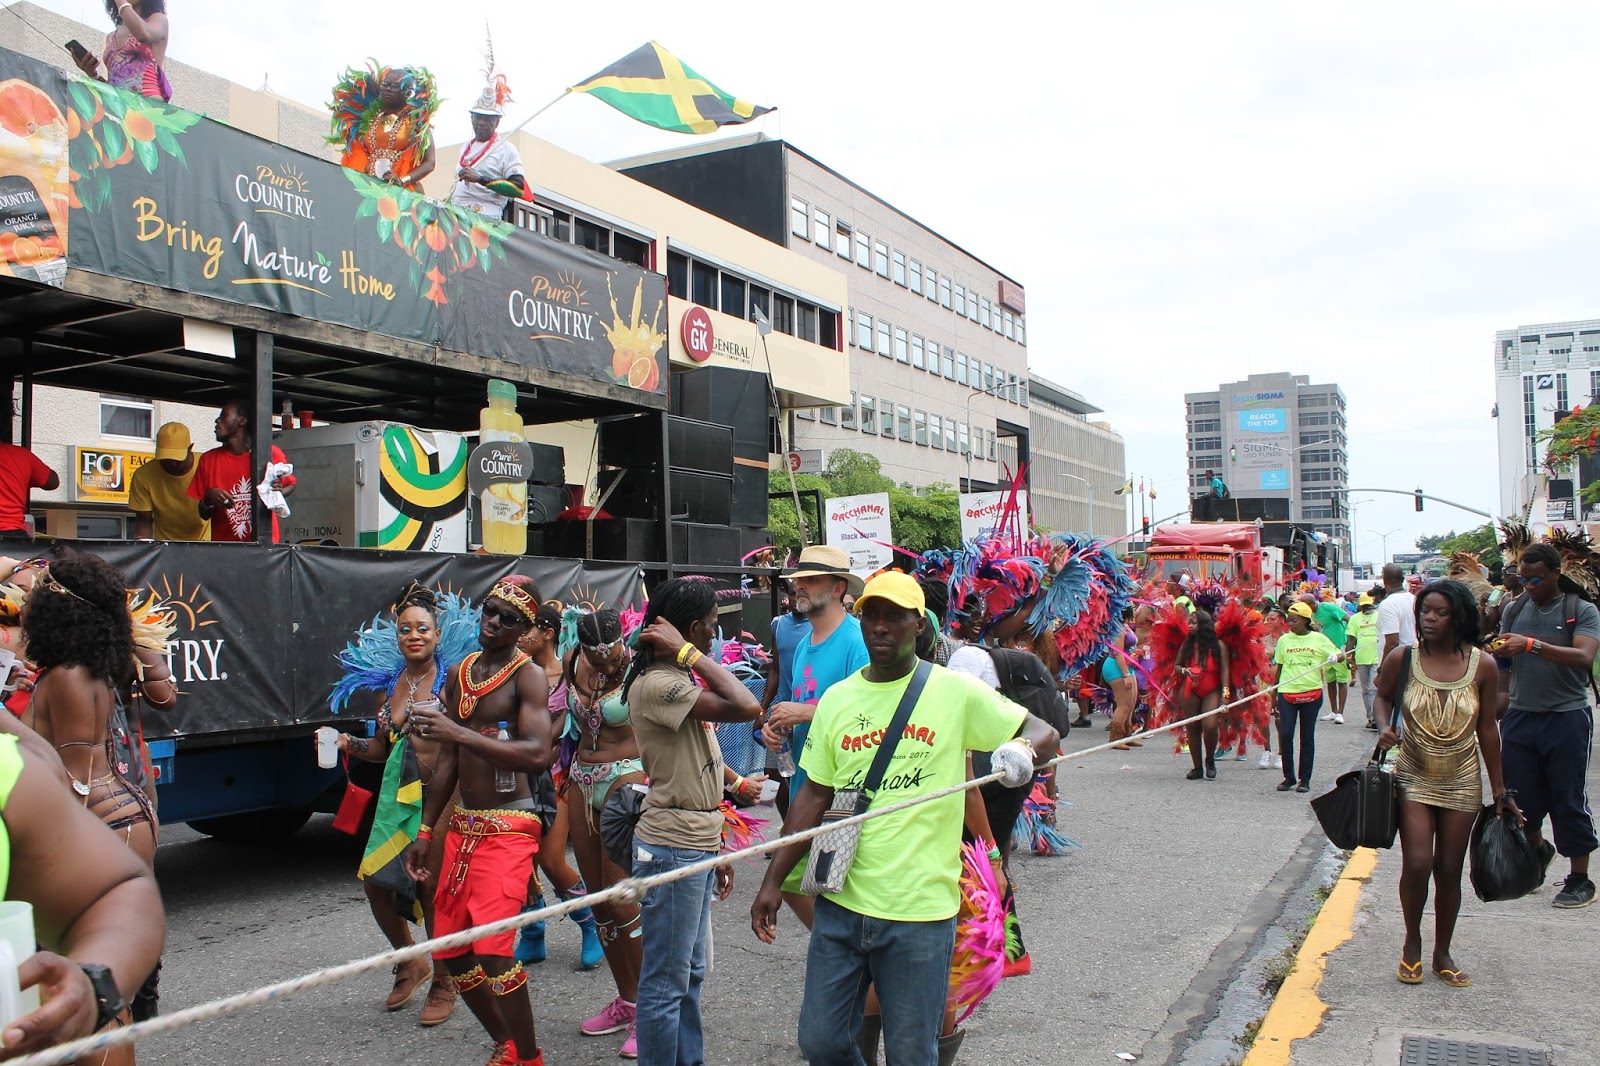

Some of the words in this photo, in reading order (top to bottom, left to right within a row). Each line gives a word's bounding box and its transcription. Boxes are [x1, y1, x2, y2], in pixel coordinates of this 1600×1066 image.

[256, 165, 293, 190] Pure
[235, 174, 315, 220] COUNTRY
[4, 212, 39, 226] ORANGE
[13, 221, 36, 233] JUICE
[133, 196, 224, 279] Bring
[232, 221, 331, 284] Nature
[339, 250, 396, 302] Home
[531, 274, 571, 305] Pure
[508, 289, 594, 341] COUNTRY
[690, 327, 709, 353] GK
[712, 337, 751, 360] GENERAL
[1249, 413, 1275, 421] REACH
[491, 449, 512, 462] Pure
[1243, 442, 1280, 453] SIGMA
[82, 452, 124, 488] FCJ
[480, 457, 523, 477] COUNTRY
[831, 504, 885, 522] BACCHANAL
[840, 532, 859, 541] Black
[841, 723, 936, 753] BACCHNAL
[908, 750, 930, 760] 2017
